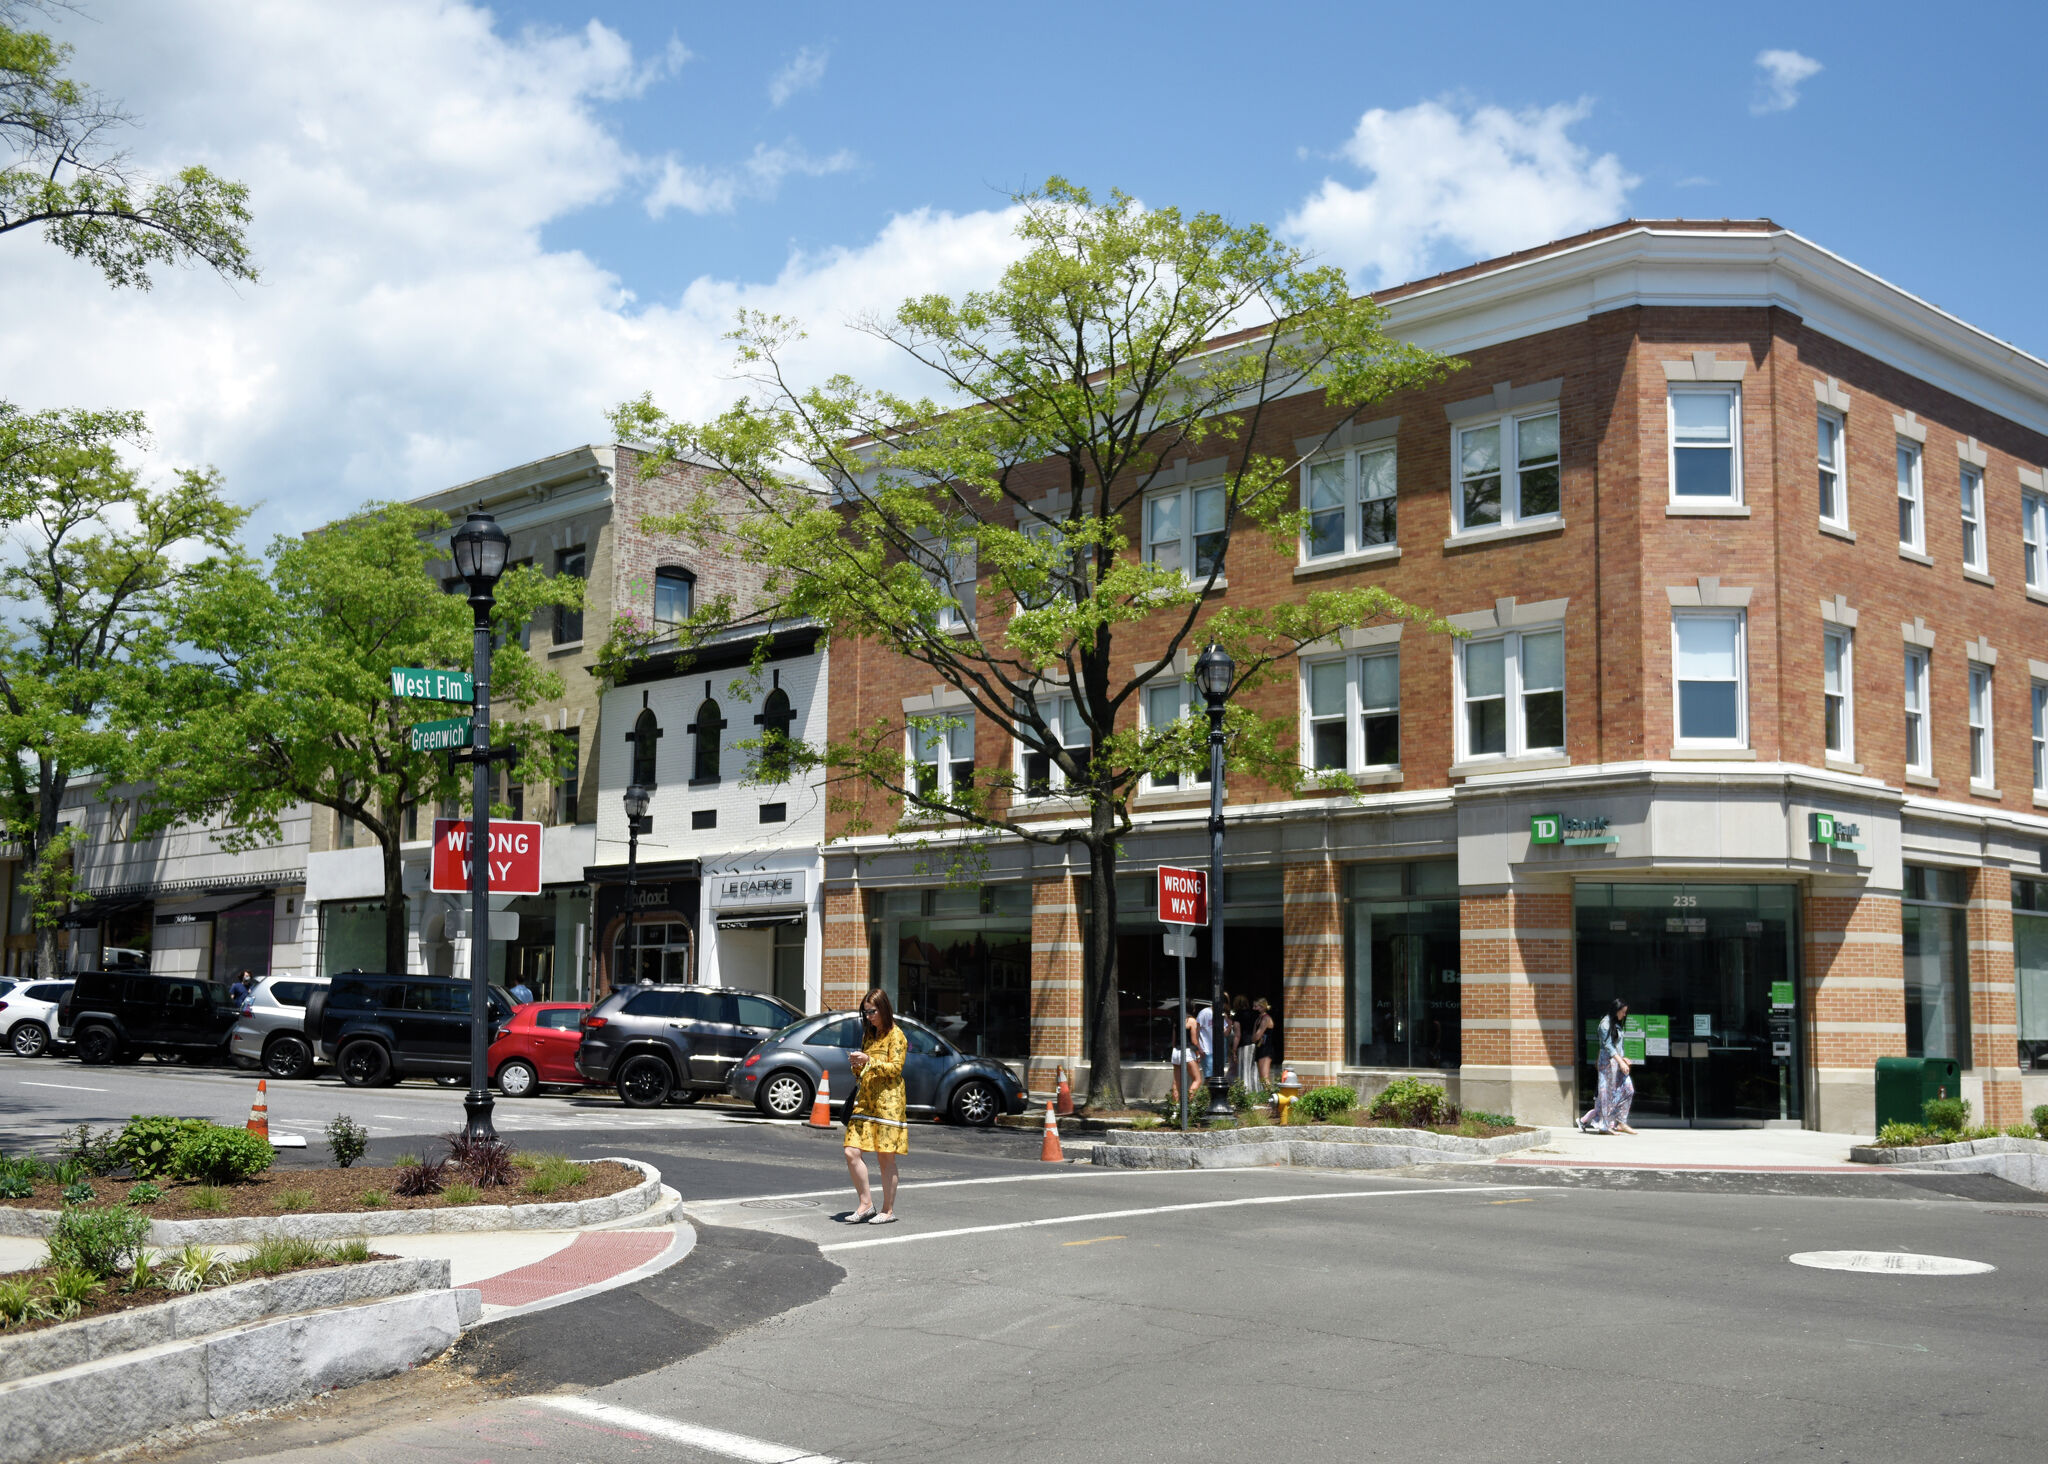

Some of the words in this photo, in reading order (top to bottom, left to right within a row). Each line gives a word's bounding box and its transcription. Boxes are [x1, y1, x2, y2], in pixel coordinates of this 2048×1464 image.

[392, 672, 431, 698] West
[437, 675, 463, 700] Elm
[464, 673, 472, 683] St
[411, 723, 464, 751] Greenwich
[1533, 819, 1556, 838] TD
[1818, 818, 1833, 838] TD
[721, 881, 738, 894] LE
[740, 878, 793, 893] CAPRICE
[1164, 875, 1202, 895] WRONG
[1171, 897, 1195, 915] WAY
[1673, 896, 1697, 907] 235
